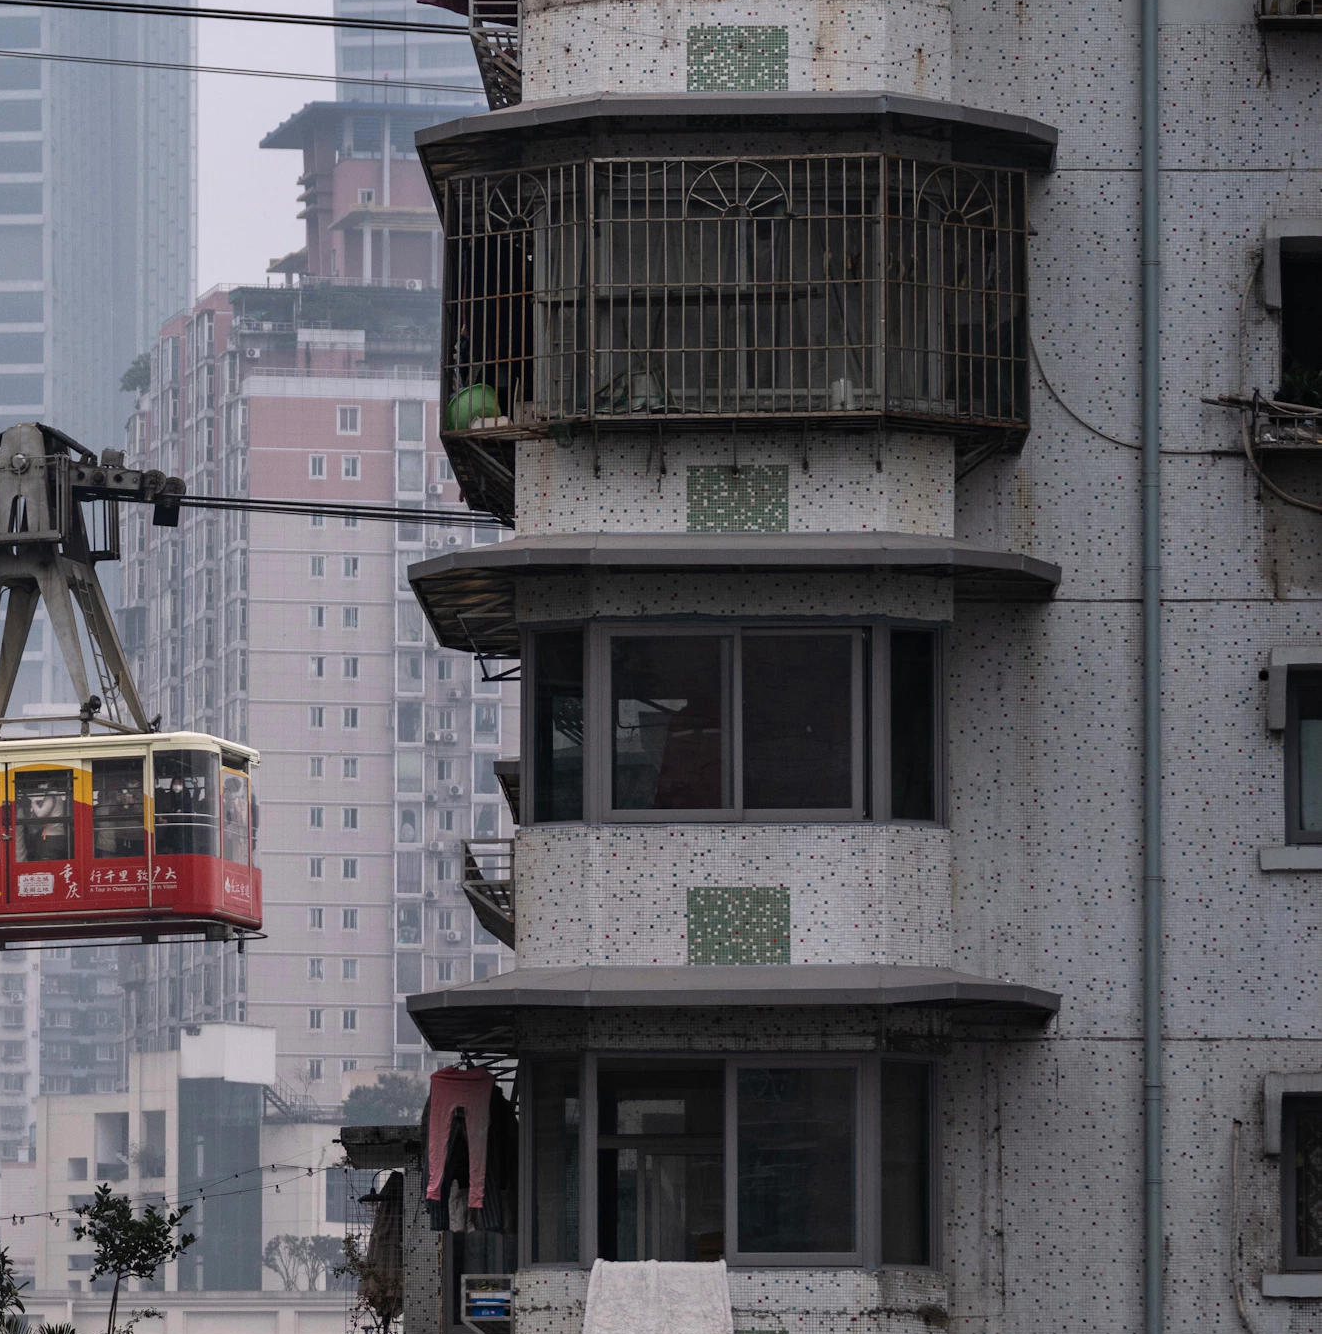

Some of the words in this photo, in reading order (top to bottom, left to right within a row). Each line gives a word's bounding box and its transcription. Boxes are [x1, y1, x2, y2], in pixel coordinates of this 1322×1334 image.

[59, 863, 81, 900] 重庆
[90, 869, 128, 883] 行千里
